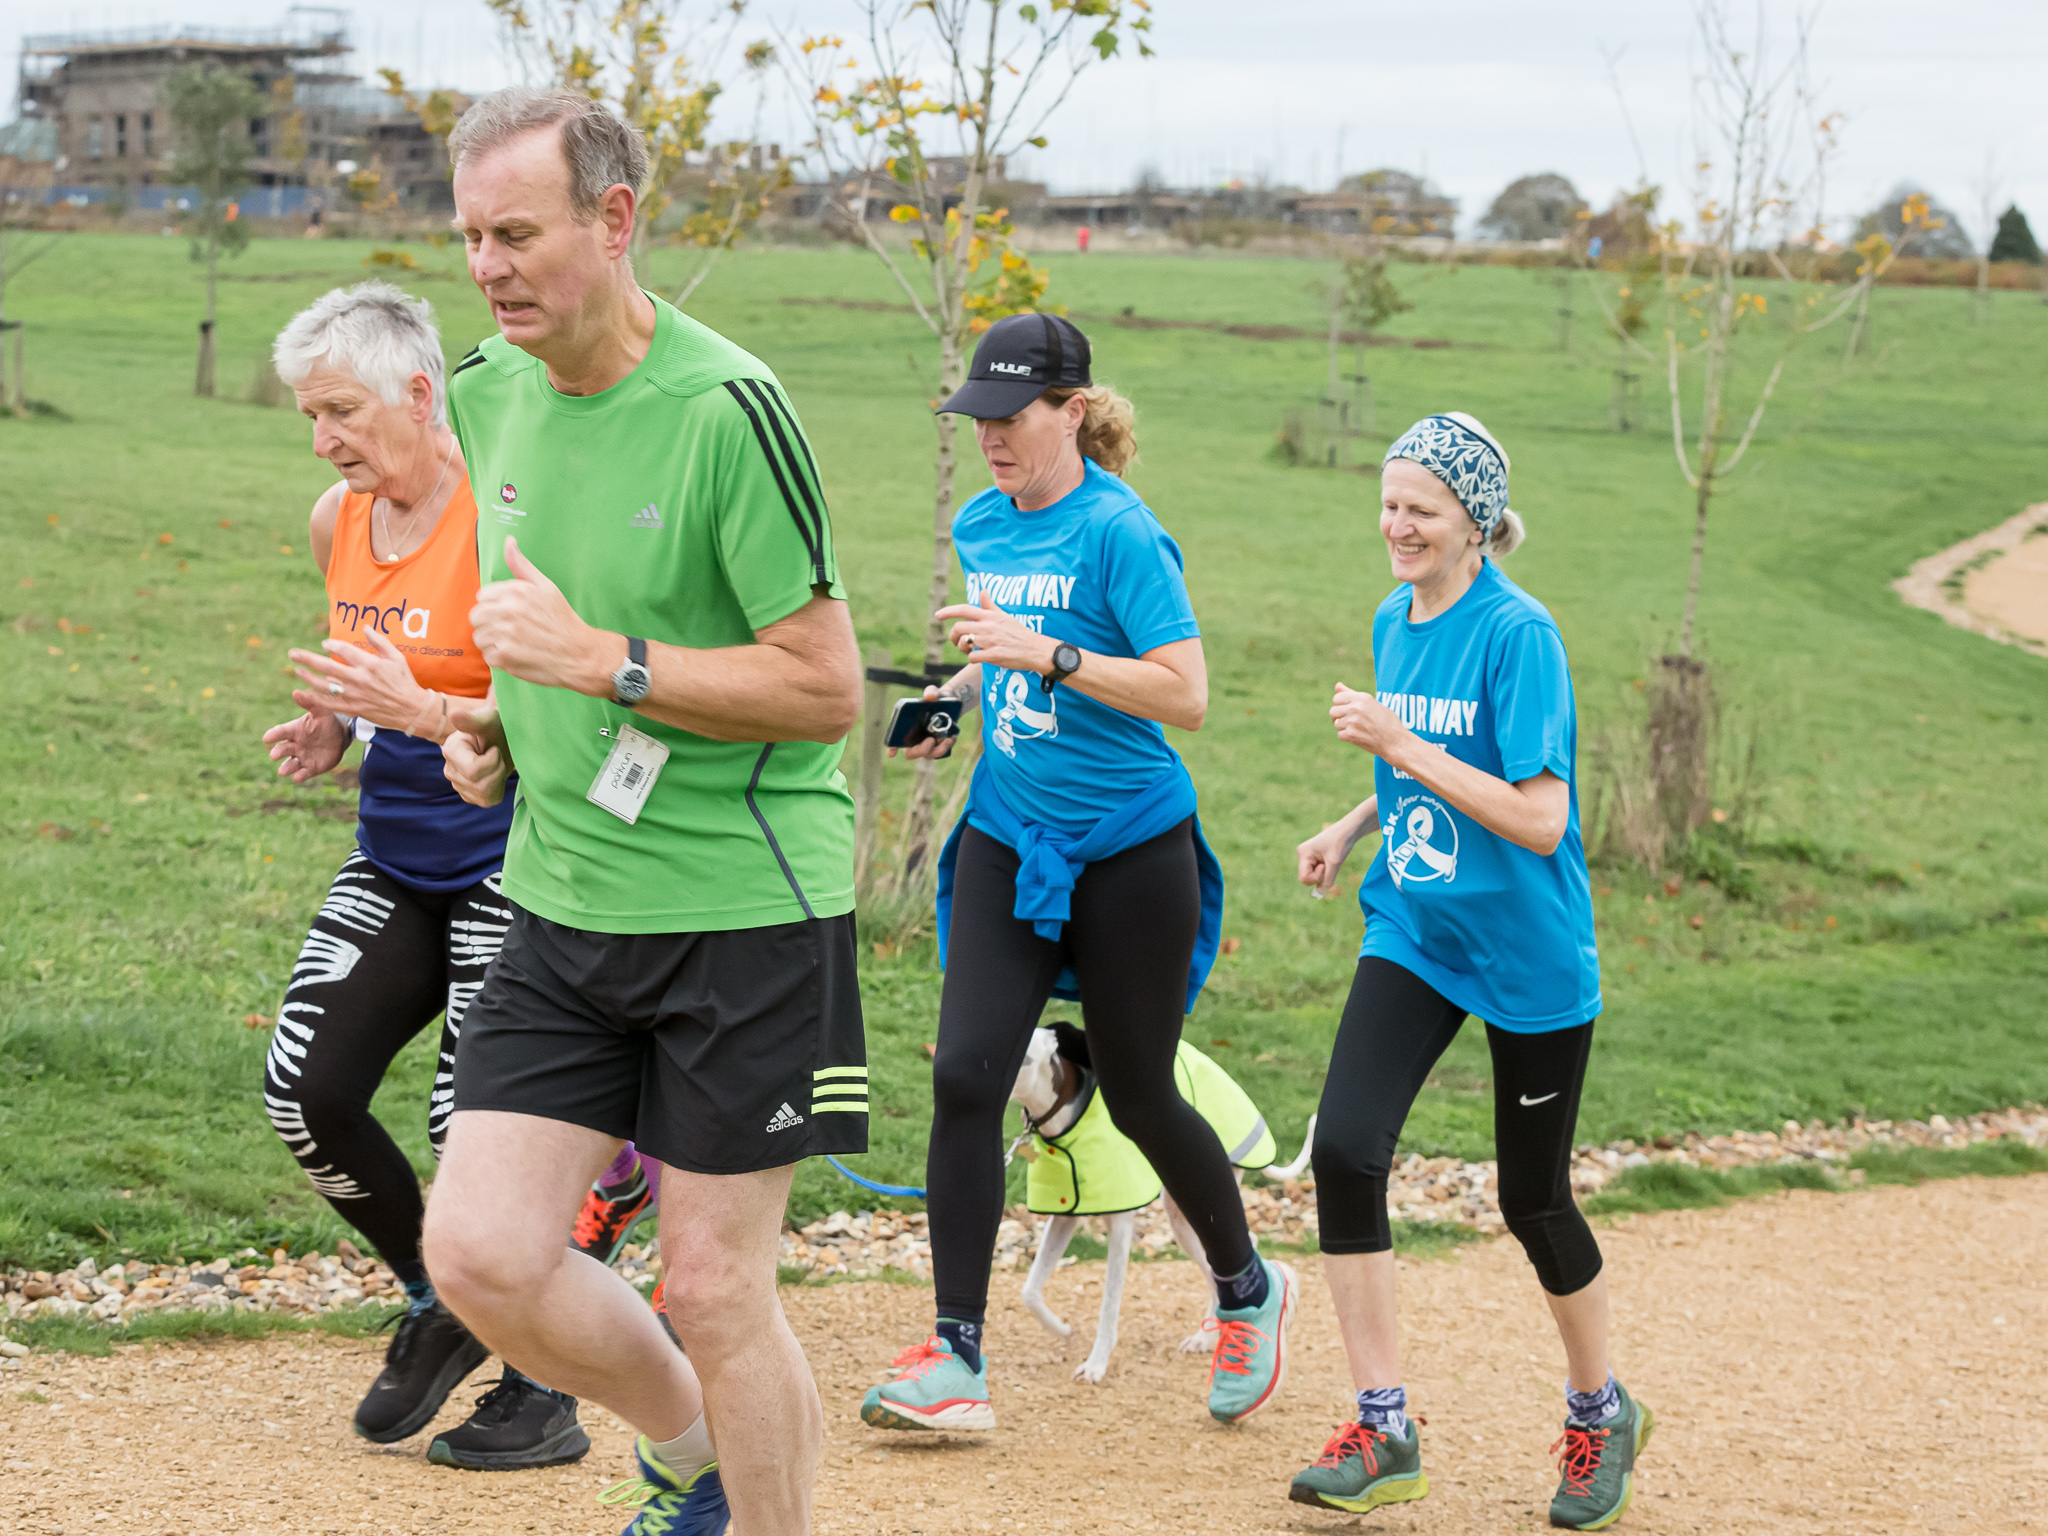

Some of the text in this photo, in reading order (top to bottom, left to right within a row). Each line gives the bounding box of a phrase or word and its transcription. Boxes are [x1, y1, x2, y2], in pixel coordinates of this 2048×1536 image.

[990, 361, 1032, 377] HUUB
[979, 572, 1028, 606] YOUR
[1027, 574, 1077, 610] WAY
[336, 598, 430, 639] mnda
[420, 646, 464, 657] disease
[1429, 697, 1479, 736] WAY
[1388, 830, 1429, 878] MOVE
[766, 1115, 804, 1133] adidas
